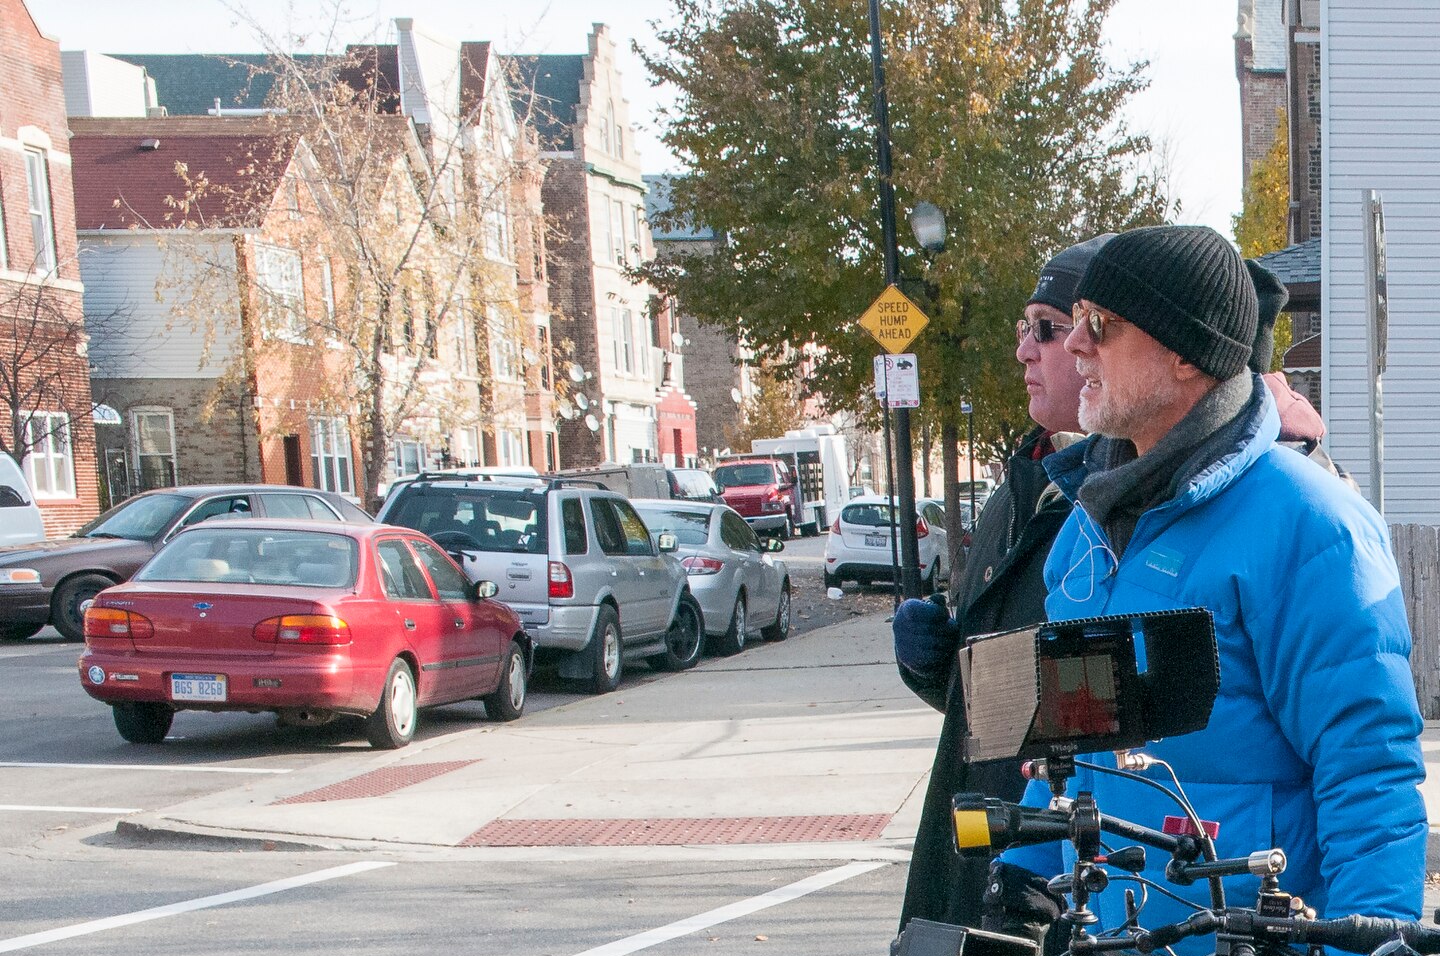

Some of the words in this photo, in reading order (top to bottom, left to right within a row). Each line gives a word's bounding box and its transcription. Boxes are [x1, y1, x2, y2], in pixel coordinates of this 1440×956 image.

[878, 302, 909, 313] SPEED
[879, 315, 908, 326] HUMP
[878, 328, 911, 339] AHEAD
[174, 681, 192, 694] BGS
